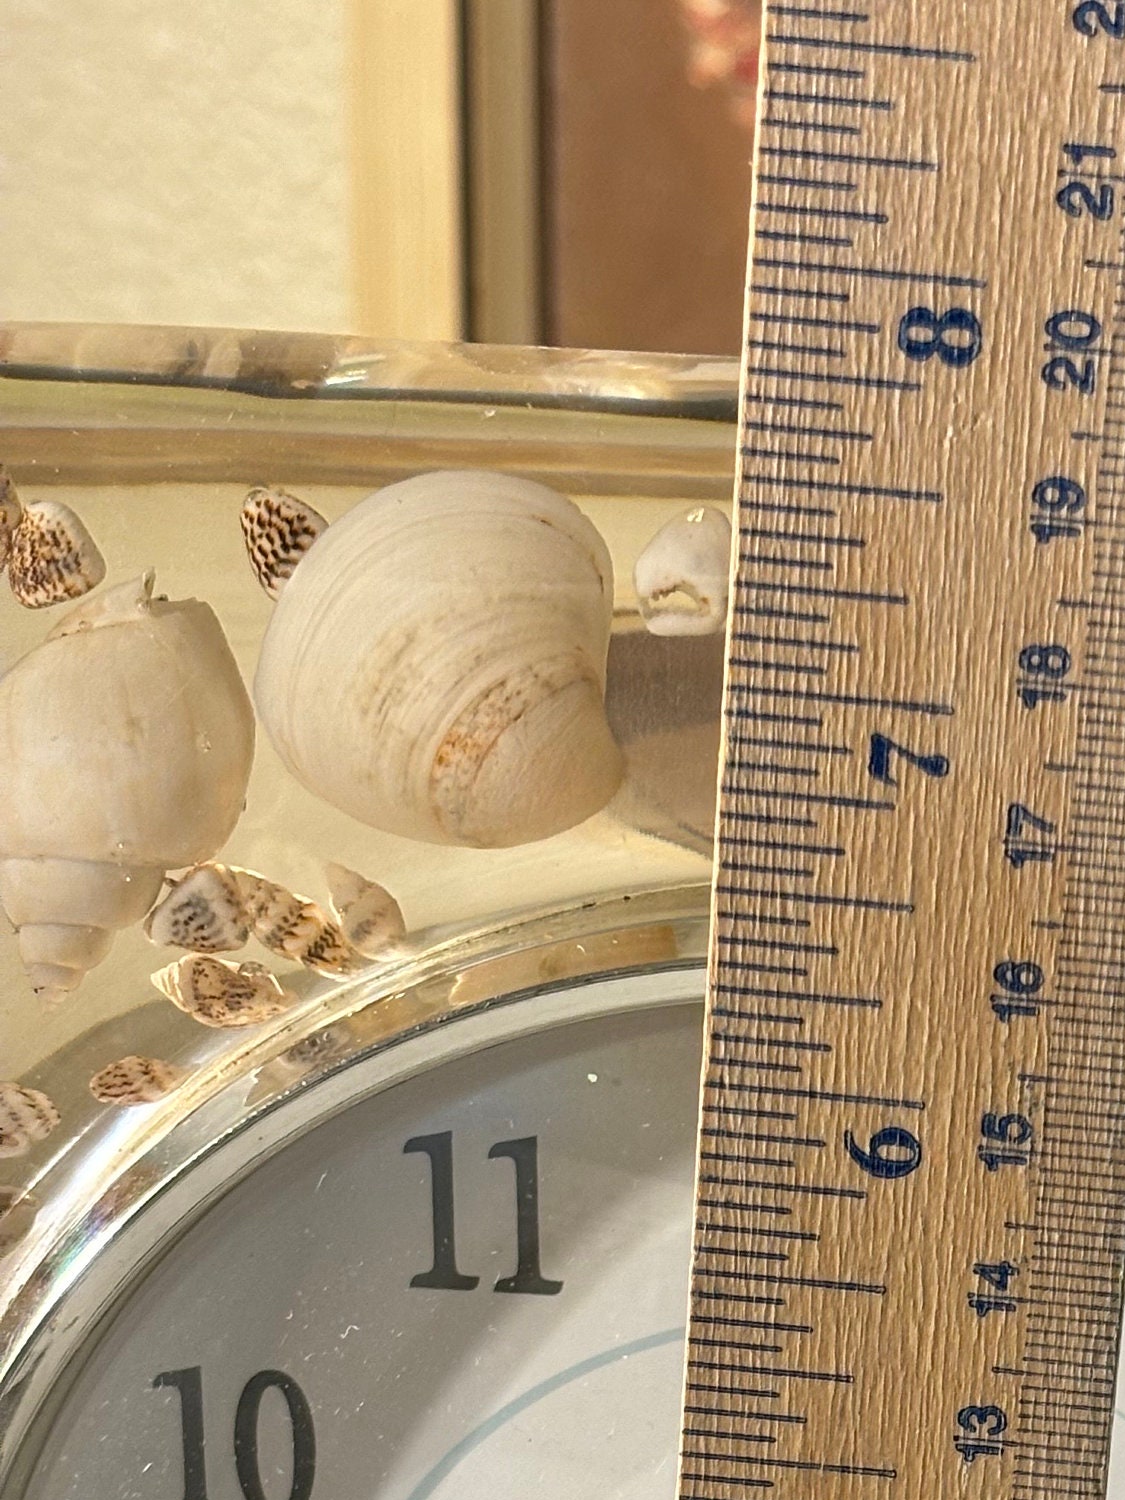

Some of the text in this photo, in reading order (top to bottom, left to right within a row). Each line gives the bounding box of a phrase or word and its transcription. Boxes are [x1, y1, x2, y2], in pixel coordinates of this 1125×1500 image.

[1056, 142, 1116, 220] 21
[899, 306, 982, 366] 8
[1042, 310, 1100, 394] 20
[1031, 475, 1086, 544] 19
[1018, 643, 1071, 708] 18
[868, 732, 949, 784] 7
[1005, 804, 1054, 868] 17
[990, 960, 1043, 1024] 16
[844, 1125, 922, 1178] 6
[979, 1112, 1032, 1172] 15
[403, 1130, 564, 1296] 11
[967, 1260, 1020, 1317] 14
[953, 1405, 1008, 1463] 13
